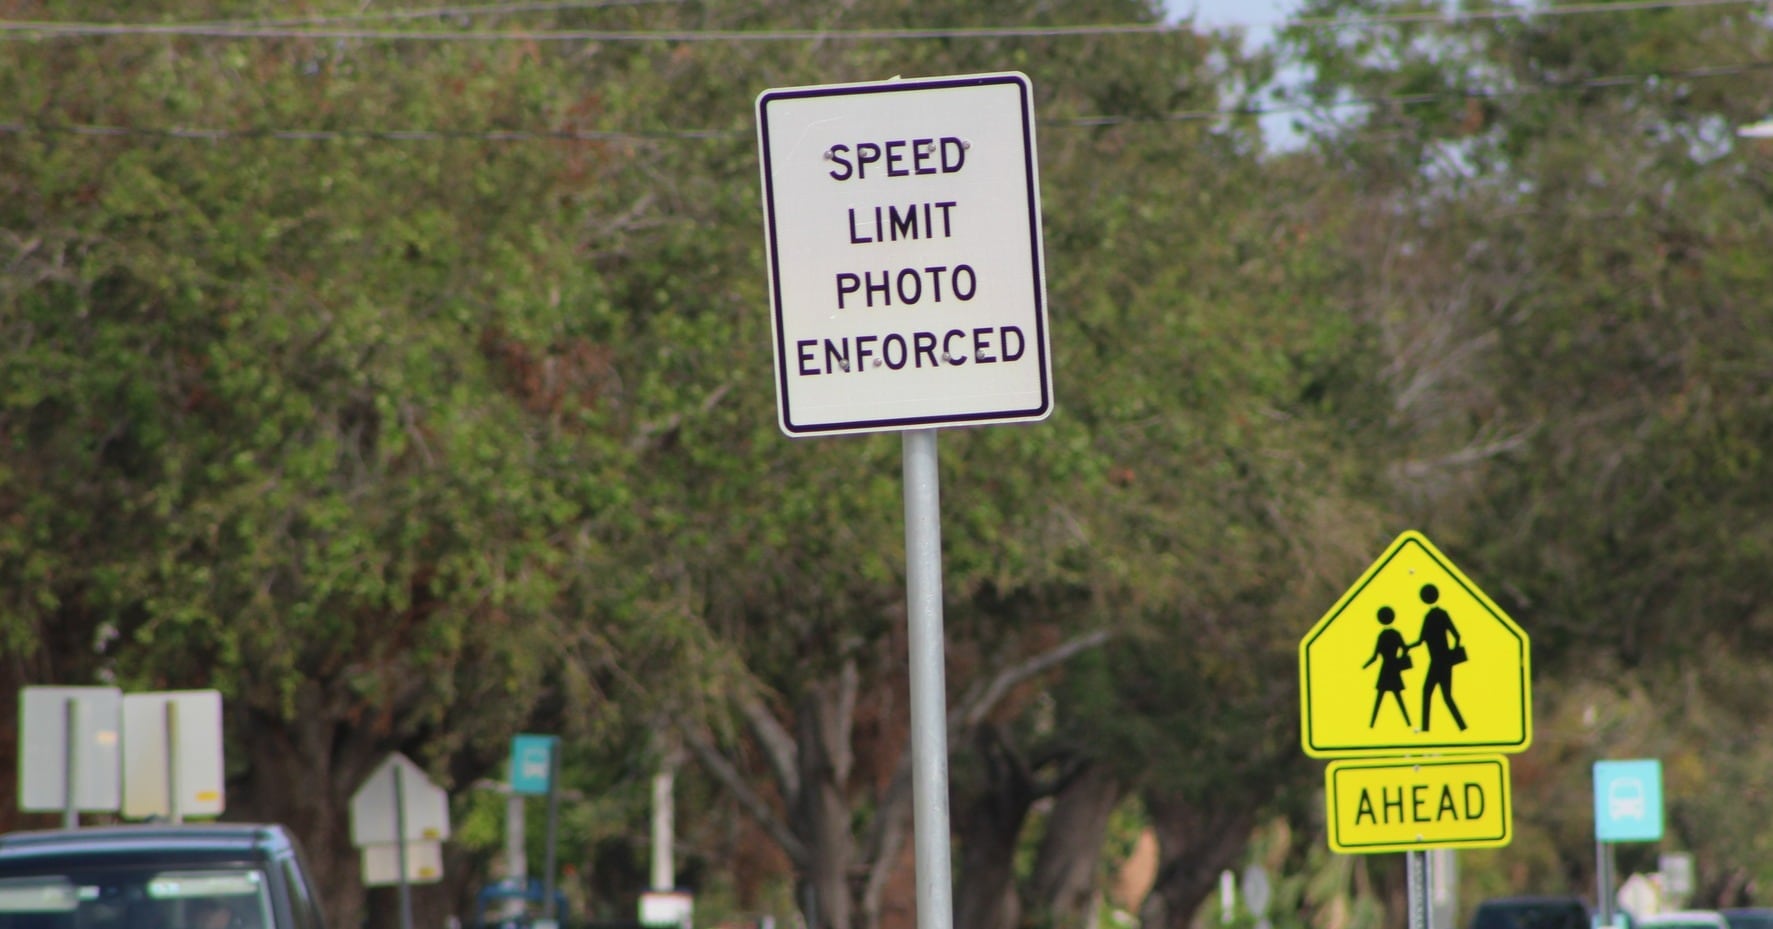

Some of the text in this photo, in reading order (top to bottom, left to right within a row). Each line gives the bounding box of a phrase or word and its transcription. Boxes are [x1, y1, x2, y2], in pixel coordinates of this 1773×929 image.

[829, 136, 966, 182] SPEED
[848, 201, 957, 244] LIMIT
[836, 264, 977, 309] PHOTO
[797, 325, 1025, 376] ENFORCED
[1355, 782, 1486, 826] AHEAD
